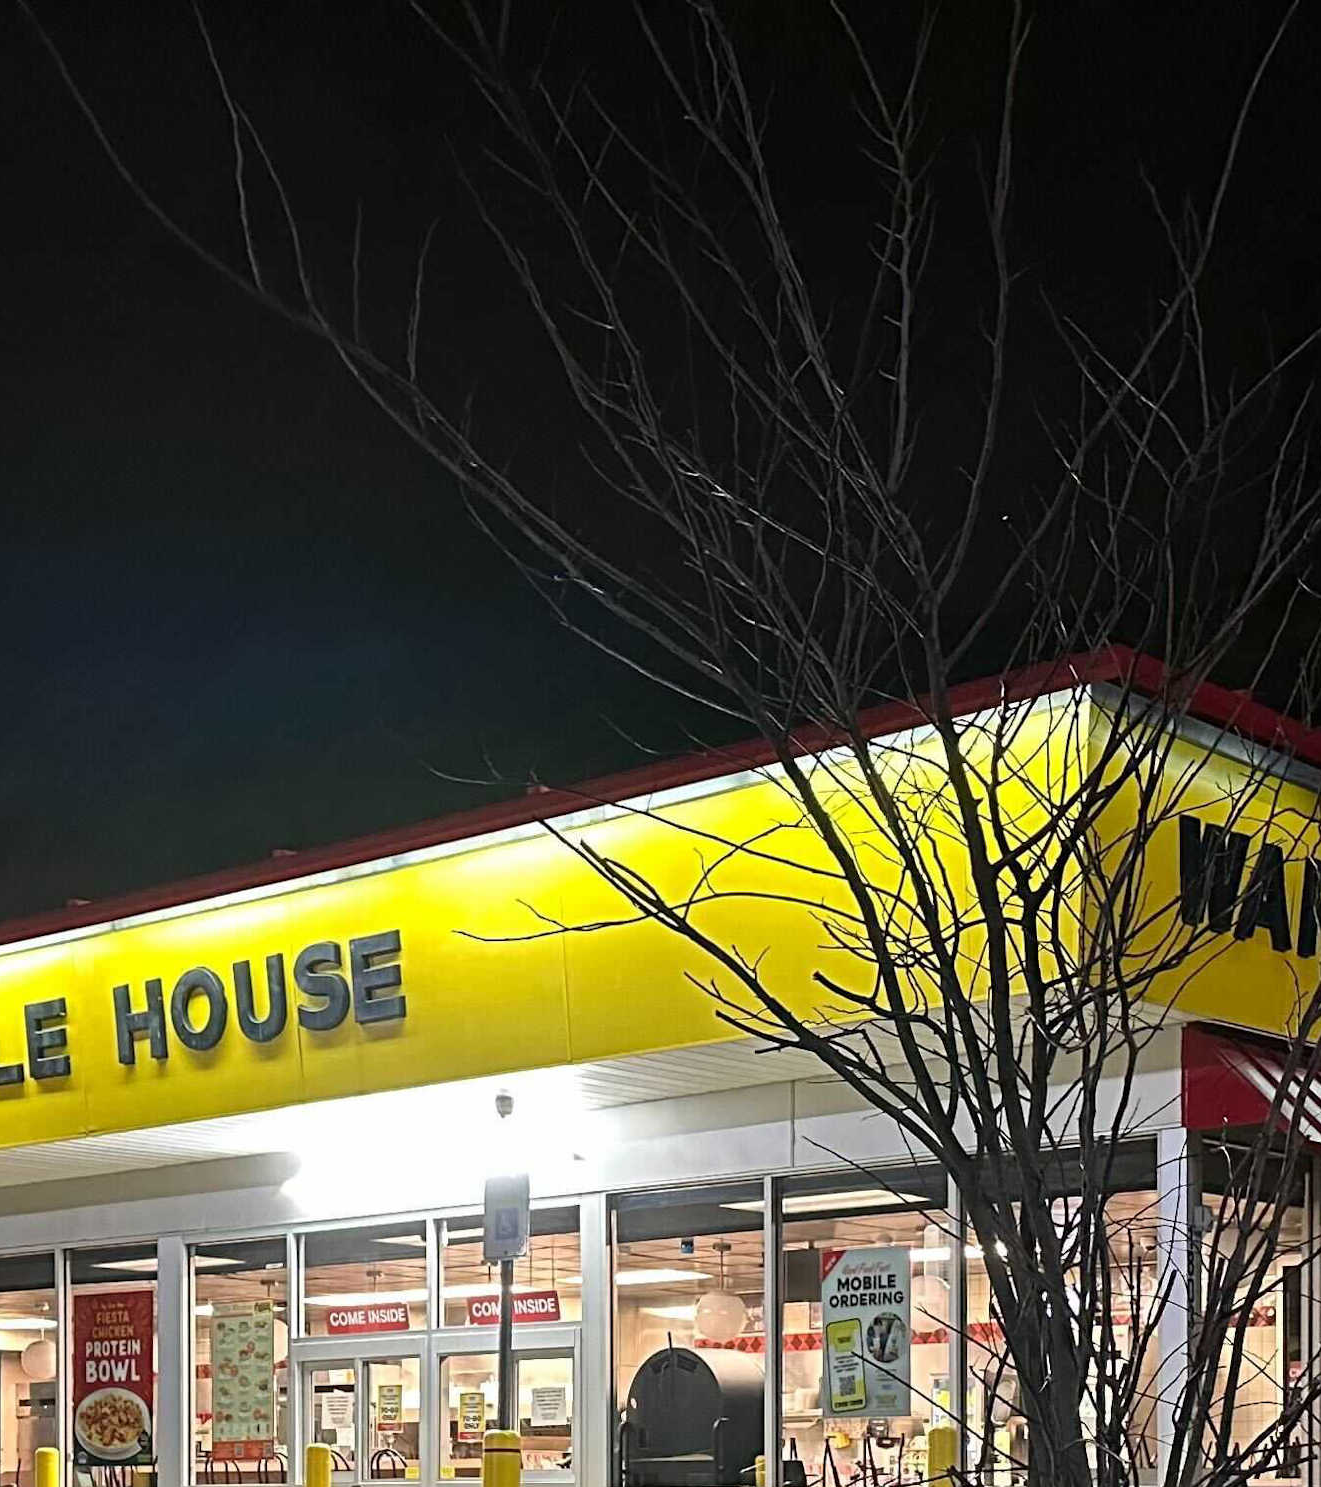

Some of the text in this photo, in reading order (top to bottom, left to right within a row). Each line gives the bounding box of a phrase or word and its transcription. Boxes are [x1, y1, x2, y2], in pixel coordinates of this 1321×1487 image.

[112, 929, 408, 1066] HOUSE
[837, 1273, 897, 1292] MOBILE
[471, 1297, 557, 1318] COM INSIDE
[829, 1290, 904, 1308] ORDERING
[96, 1309, 130, 1324] FIESTA
[329, 1307, 407, 1326] COME INSIDE
[93, 1324, 135, 1339] CHICKEN
[85, 1339, 141, 1358] PROTEIN
[85, 1358, 141, 1383] BOWL
